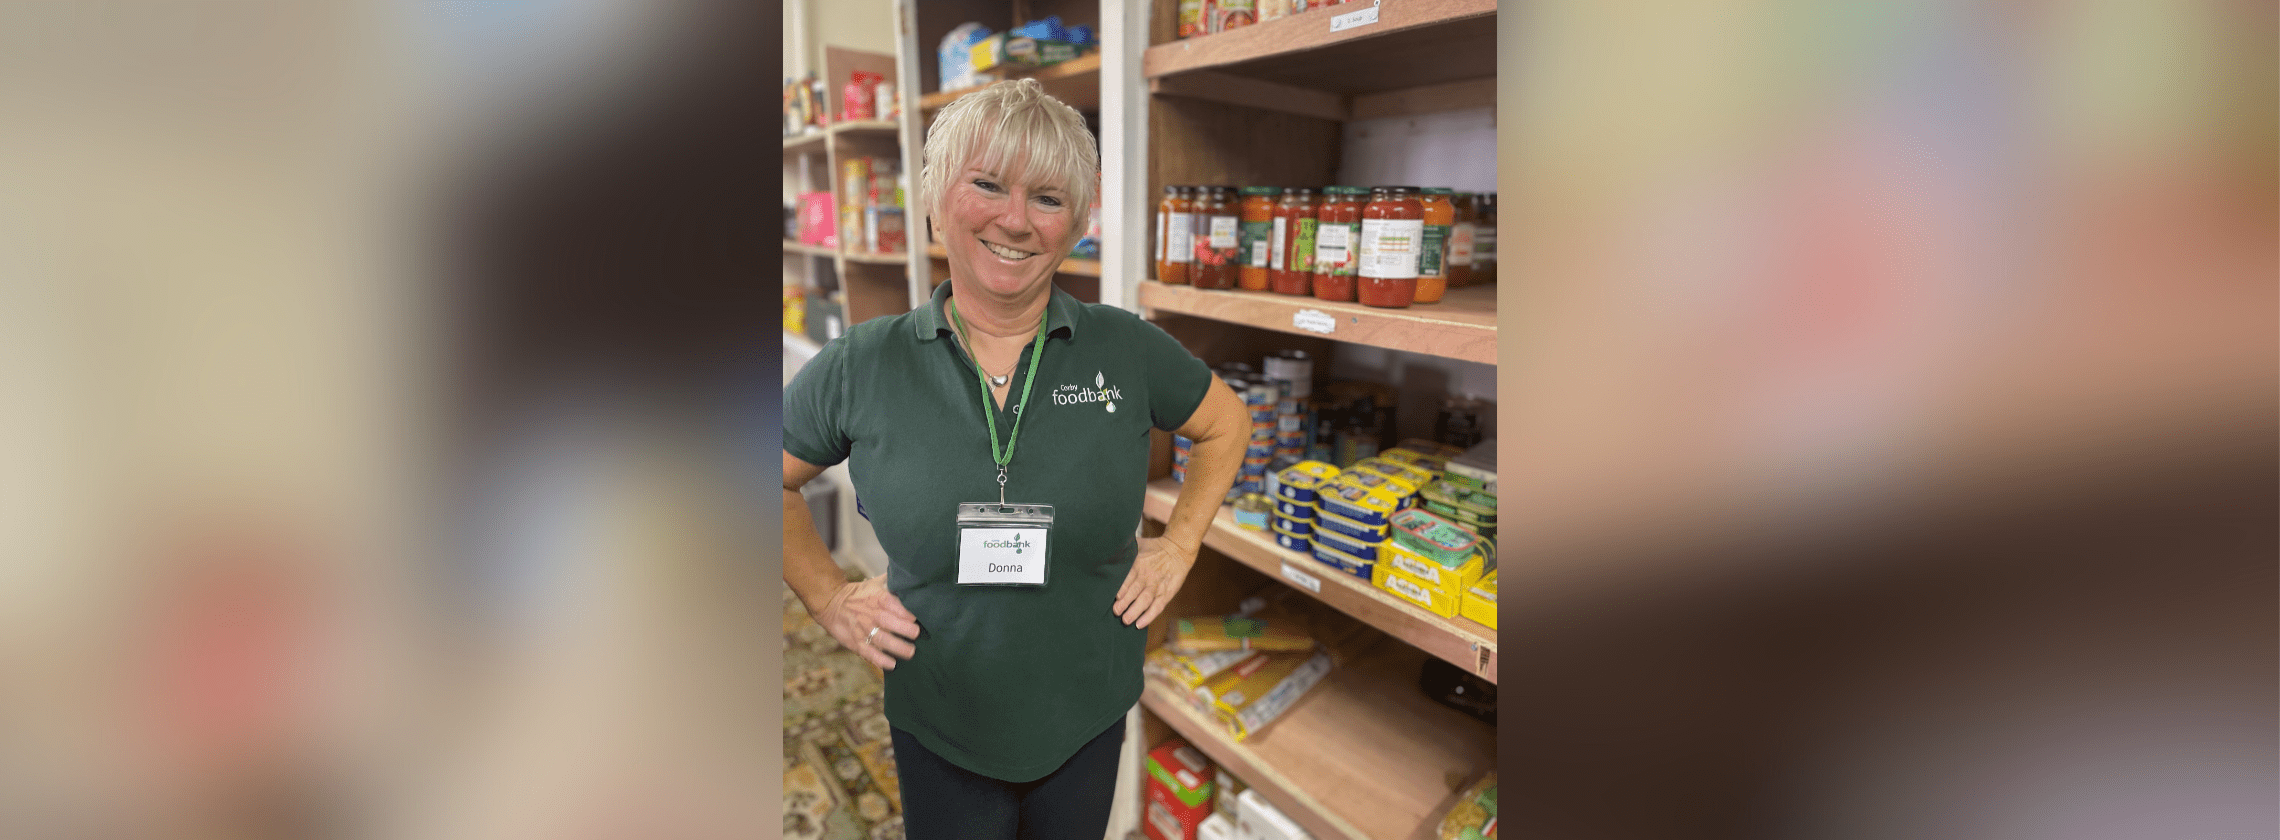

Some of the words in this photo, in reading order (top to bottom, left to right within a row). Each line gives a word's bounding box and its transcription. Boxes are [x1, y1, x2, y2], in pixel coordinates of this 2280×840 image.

[1060, 383, 1078, 391] Corby
[1052, 385, 1123, 405] foodbank
[983, 540, 1031, 548] foodbank
[988, 562, 1023, 573] Donna
[1391, 554, 1441, 585] ASDA
[1384, 574, 1432, 607] ASDA
